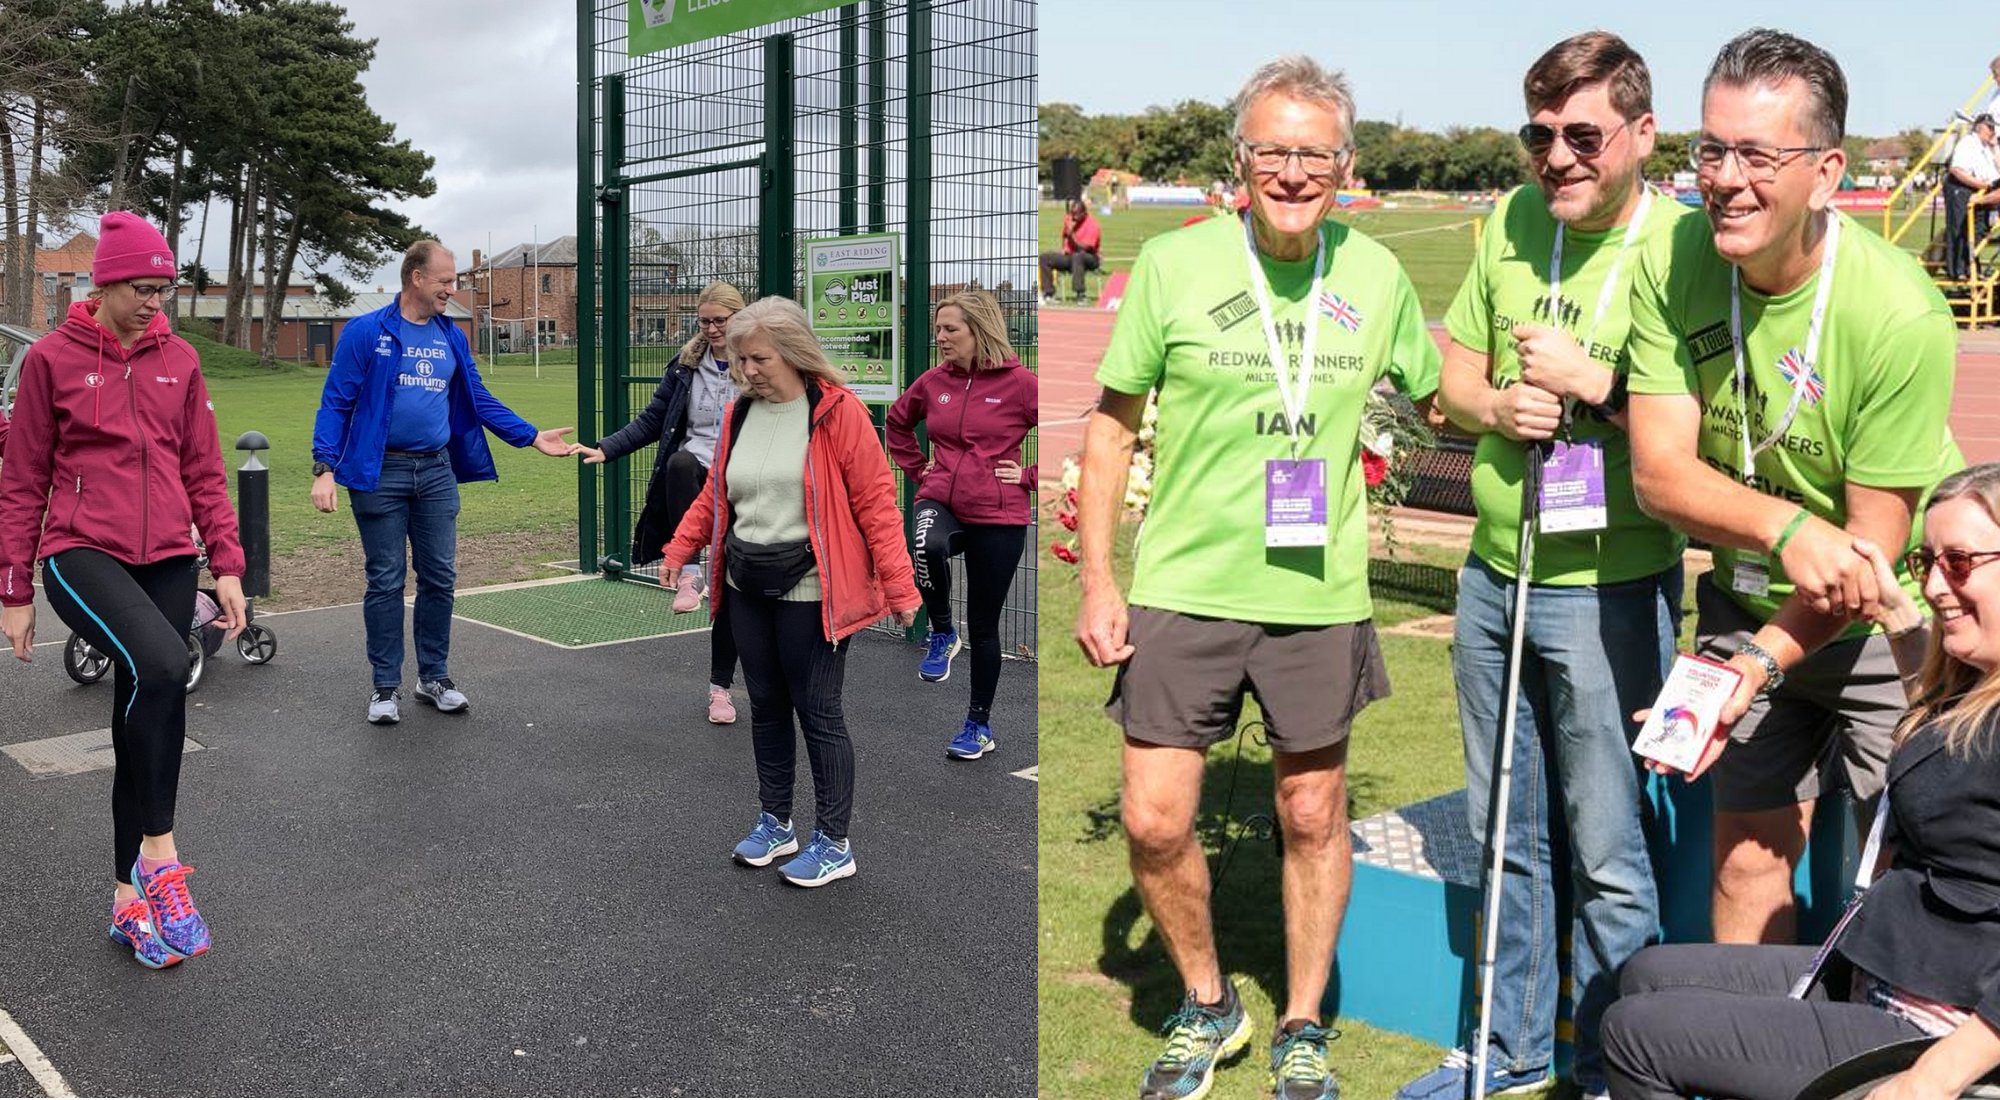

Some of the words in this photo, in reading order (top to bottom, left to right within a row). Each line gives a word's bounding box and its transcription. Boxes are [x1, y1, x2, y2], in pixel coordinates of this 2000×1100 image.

[830, 249, 851, 258] EAST
[853, 247, 888, 257] RIDING
[850, 278, 879, 291] Just
[851, 291, 879, 305] Play
[1212, 309, 1231, 328] ON
[1227, 295, 1256, 318] TOUR
[820, 343, 851, 351] ootwear
[1700, 327, 1733, 353] TOUR
[1208, 352, 1273, 367] REDWA
[1288, 354, 1364, 372] RNNERS
[398, 373, 447, 389] fitmums
[1245, 373, 1278, 383] MILTO
[1291, 373, 1336, 384] KNES
[1256, 411, 1316, 436] IAN
[1701, 402, 1749, 426] DWAY
[1754, 413, 1824, 457] RNERS
[915, 517, 935, 588] fitmums
